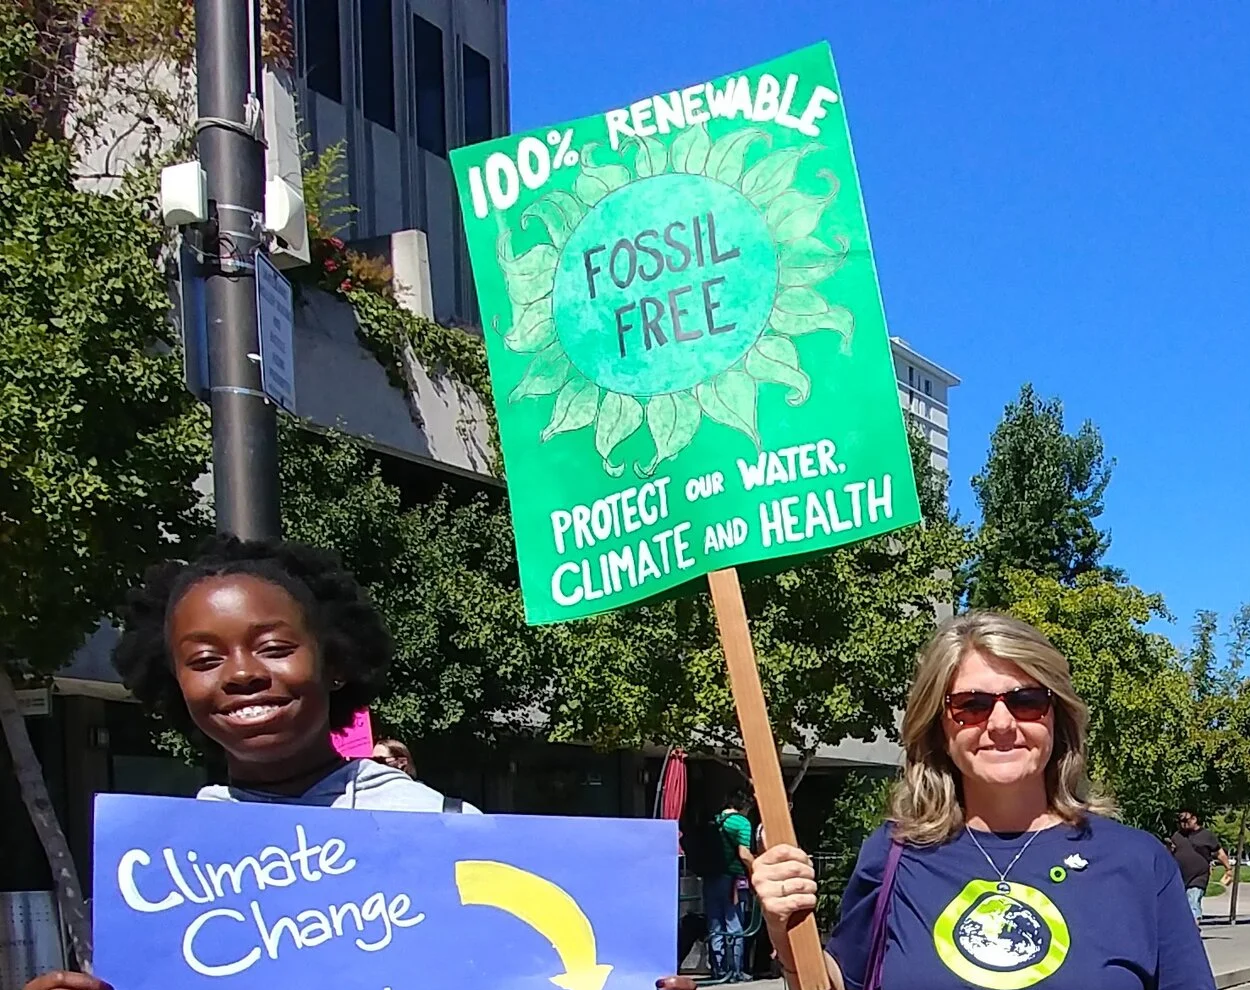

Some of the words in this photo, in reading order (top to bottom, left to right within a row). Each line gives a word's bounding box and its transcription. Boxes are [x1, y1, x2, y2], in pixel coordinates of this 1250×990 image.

[467, 127, 581, 219] 100%
[606, 71, 839, 151] RENEWABLE
[583, 210, 741, 300] FOSSIL
[613, 276, 737, 359] FREE
[550, 475, 671, 554] PROTECT
[684, 470, 725, 500] OUR
[550, 521, 696, 607] CLIMATE
[704, 515, 749, 556] AND
[758, 473, 894, 549] HEALTH
[117, 824, 357, 913] Climate
[181, 891, 426, 978] Change
